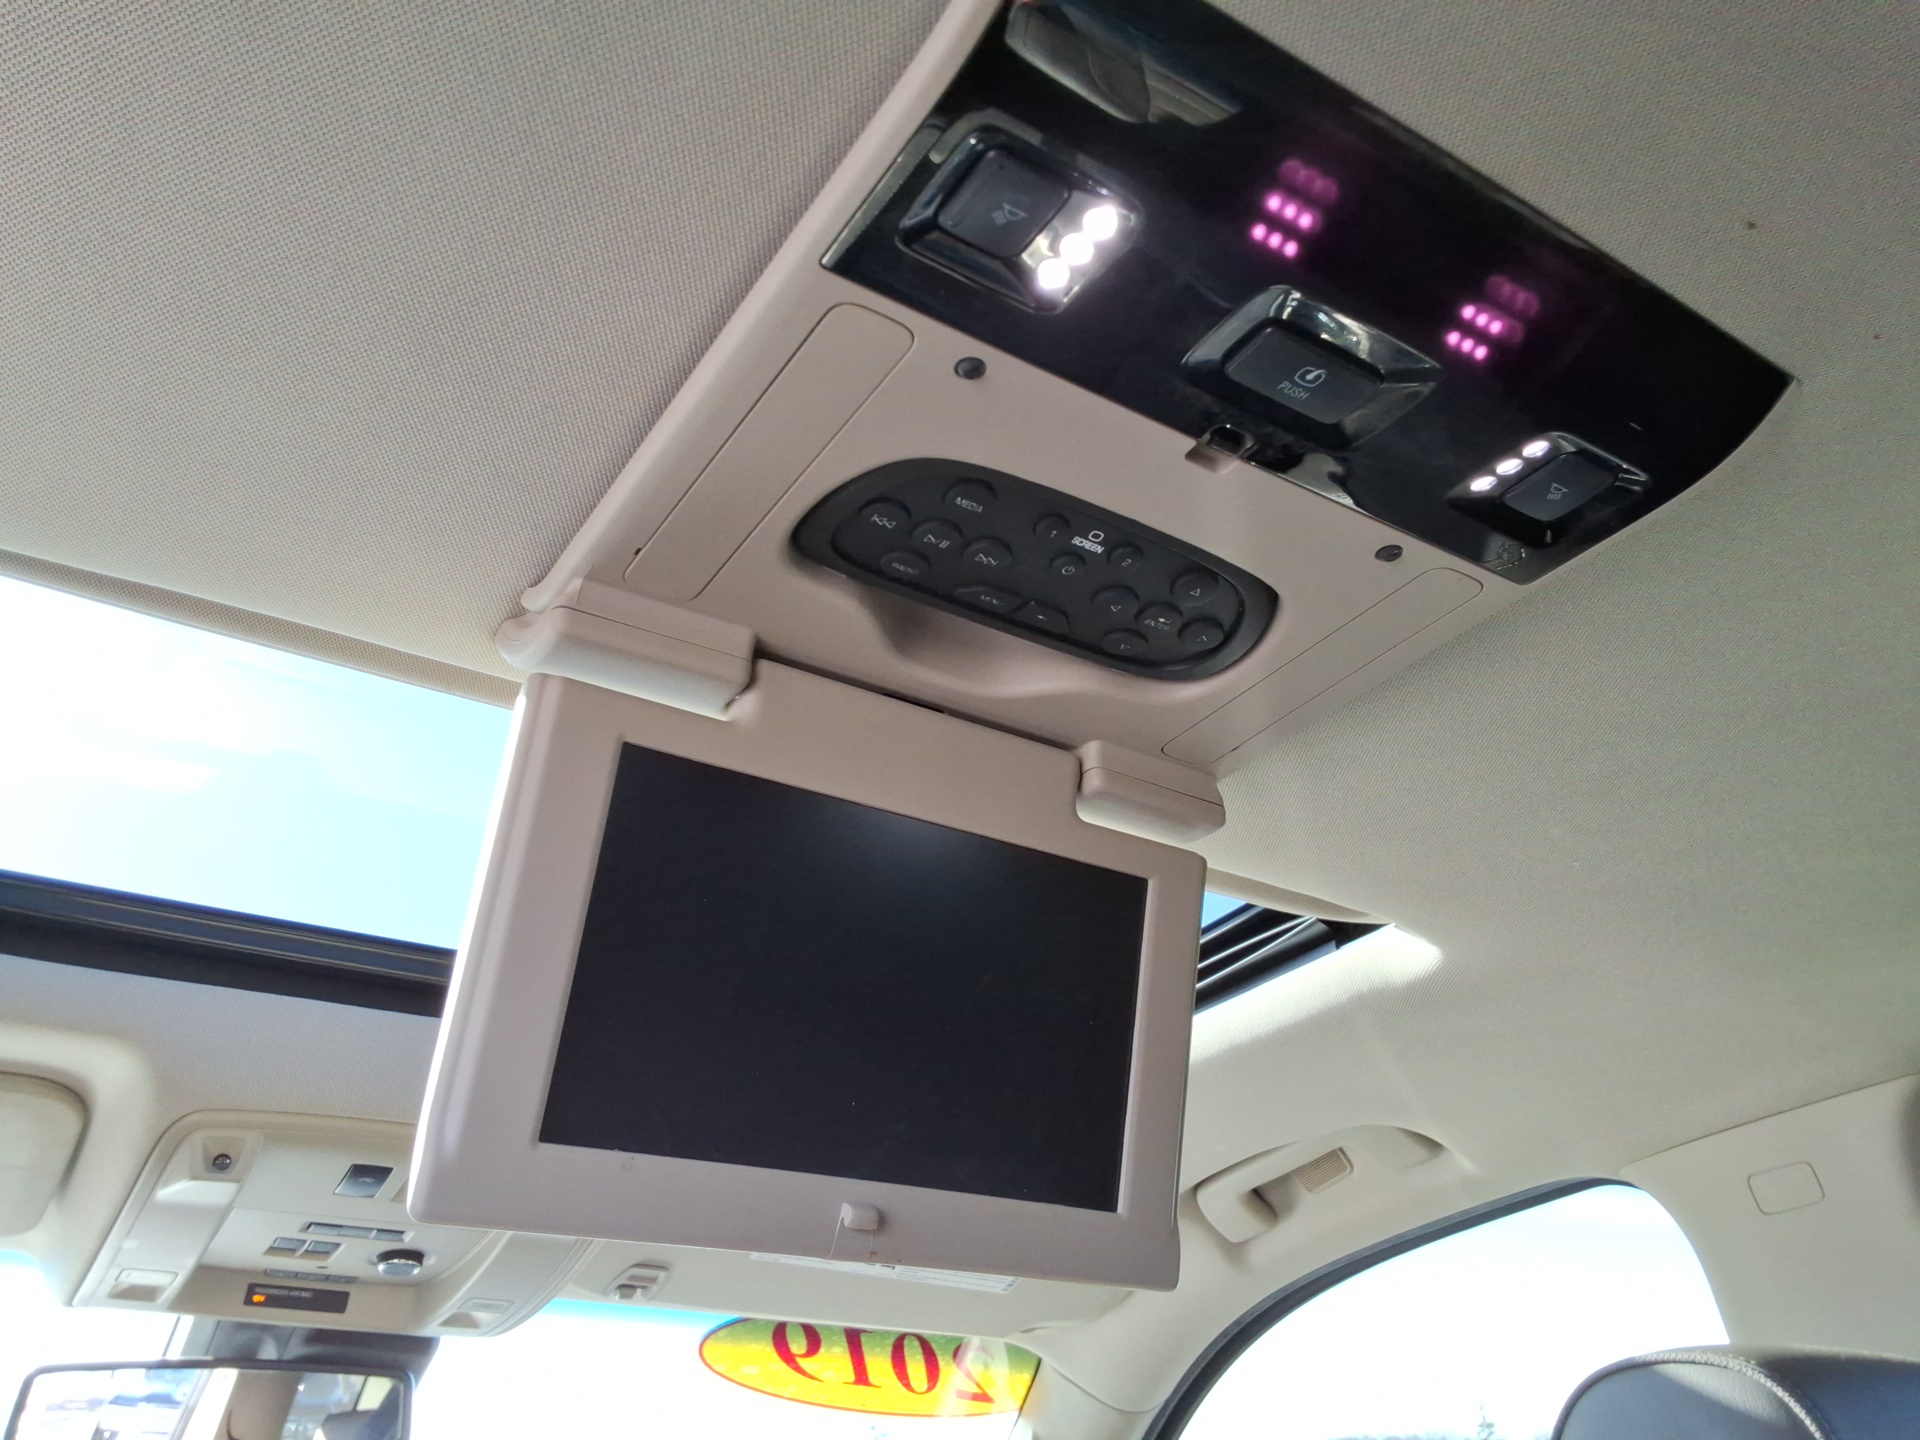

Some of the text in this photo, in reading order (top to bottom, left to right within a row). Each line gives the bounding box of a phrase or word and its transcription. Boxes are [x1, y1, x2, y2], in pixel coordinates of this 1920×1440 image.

[1277, 381, 1310, 400] PUSH
[954, 497, 983, 513] MEDIA
[1071, 536, 1104, 553] SCREEN
[1143, 618, 1171, 631] ENTER
